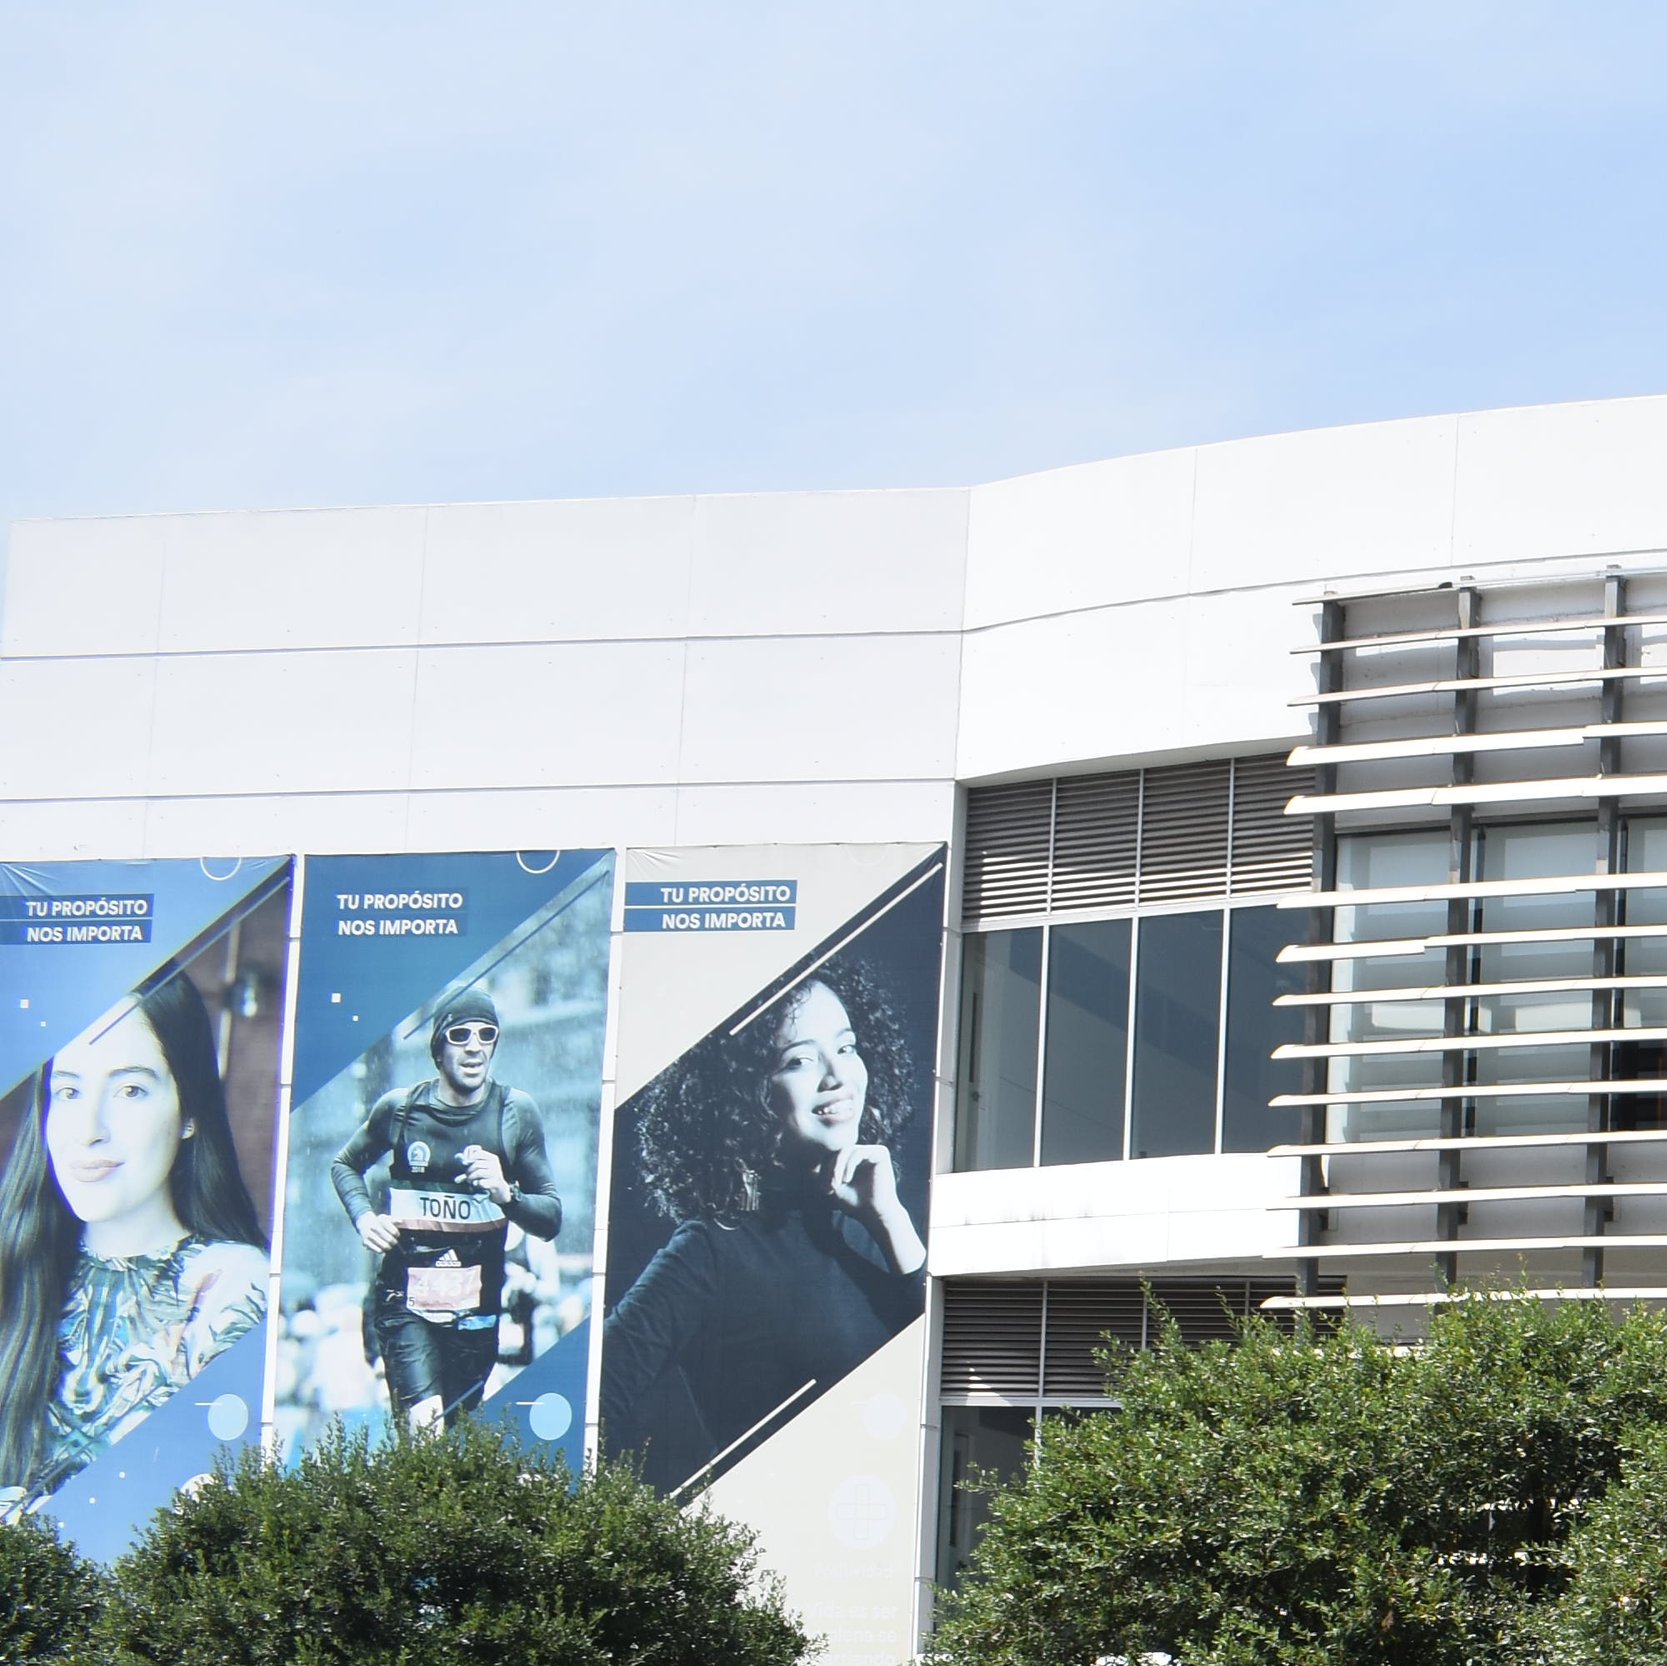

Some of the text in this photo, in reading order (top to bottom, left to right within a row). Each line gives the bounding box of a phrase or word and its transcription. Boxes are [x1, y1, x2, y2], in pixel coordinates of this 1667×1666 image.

[336, 889, 463, 911] TU PROPÓSITO
[660, 882, 791, 904] TU PROPÓSITO
[26, 897, 148, 917] TU PROPÓSITO
[337, 918, 459, 936] NOS IMPORTA
[661, 911, 786, 930] NOS IMPORTA
[26, 925, 143, 943] NOS IMPORTA
[420, 1195, 471, 1219] TOÑO
